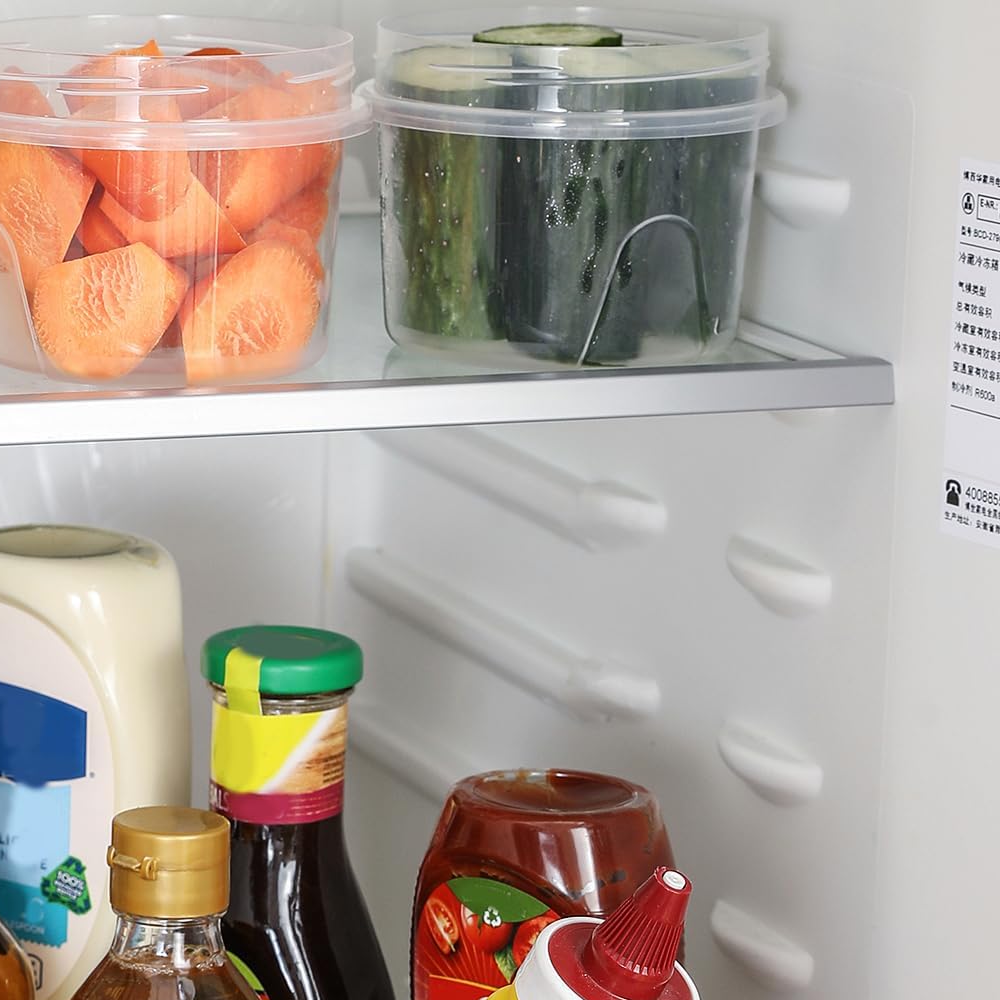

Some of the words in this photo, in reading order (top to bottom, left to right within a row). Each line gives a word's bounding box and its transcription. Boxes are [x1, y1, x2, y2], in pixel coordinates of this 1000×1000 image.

[954, 321, 1000, 341] 冷藏室有效容
[965, 486, 1000, 506] 400885
